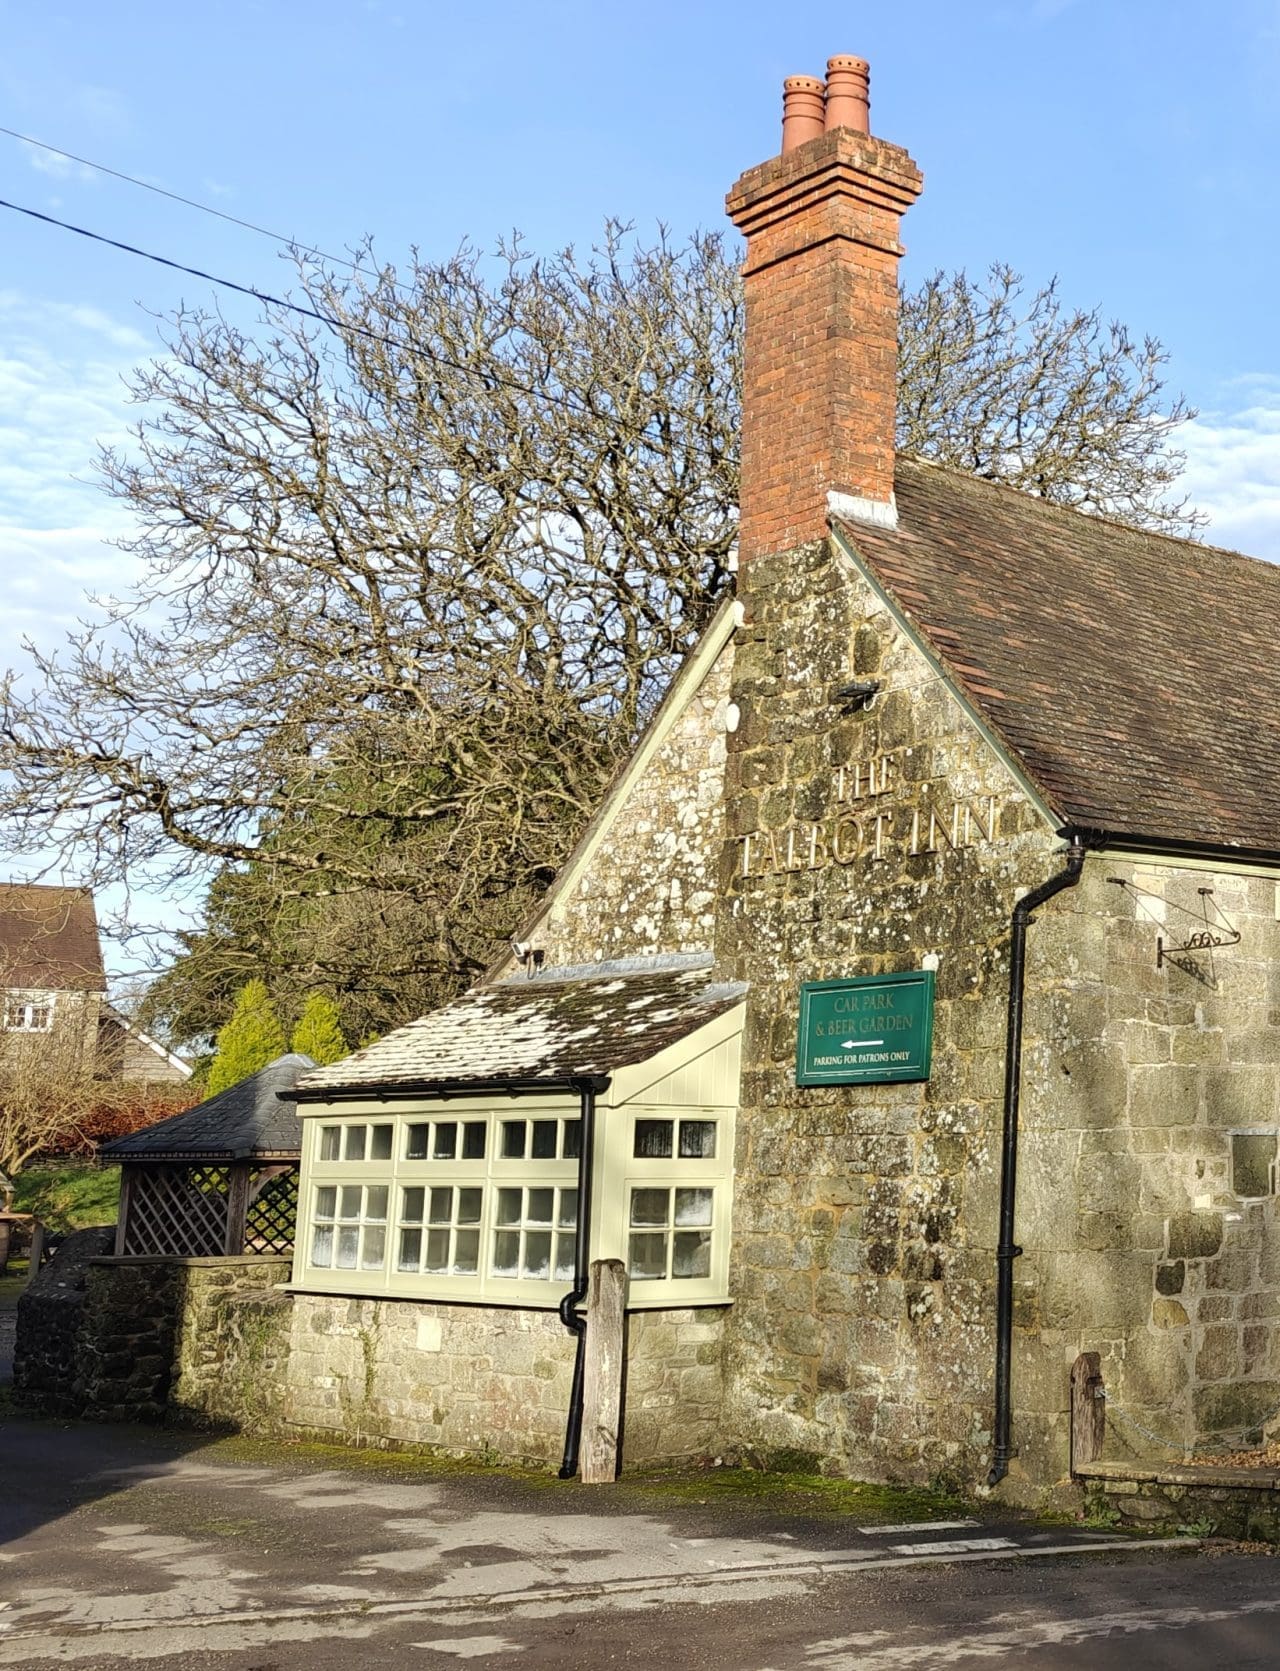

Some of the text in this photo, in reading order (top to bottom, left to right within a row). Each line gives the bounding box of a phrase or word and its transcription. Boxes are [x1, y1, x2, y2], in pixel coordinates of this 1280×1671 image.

[833, 756, 894, 802] THE
[739, 796, 997, 880] TALBOT INN
[834, 993, 895, 1013] CAR PARK
[815, 1014, 913, 1036] & BEER GARDEN
[813, 1050, 911, 1066] PARKING FOR PATRONS ONLY
